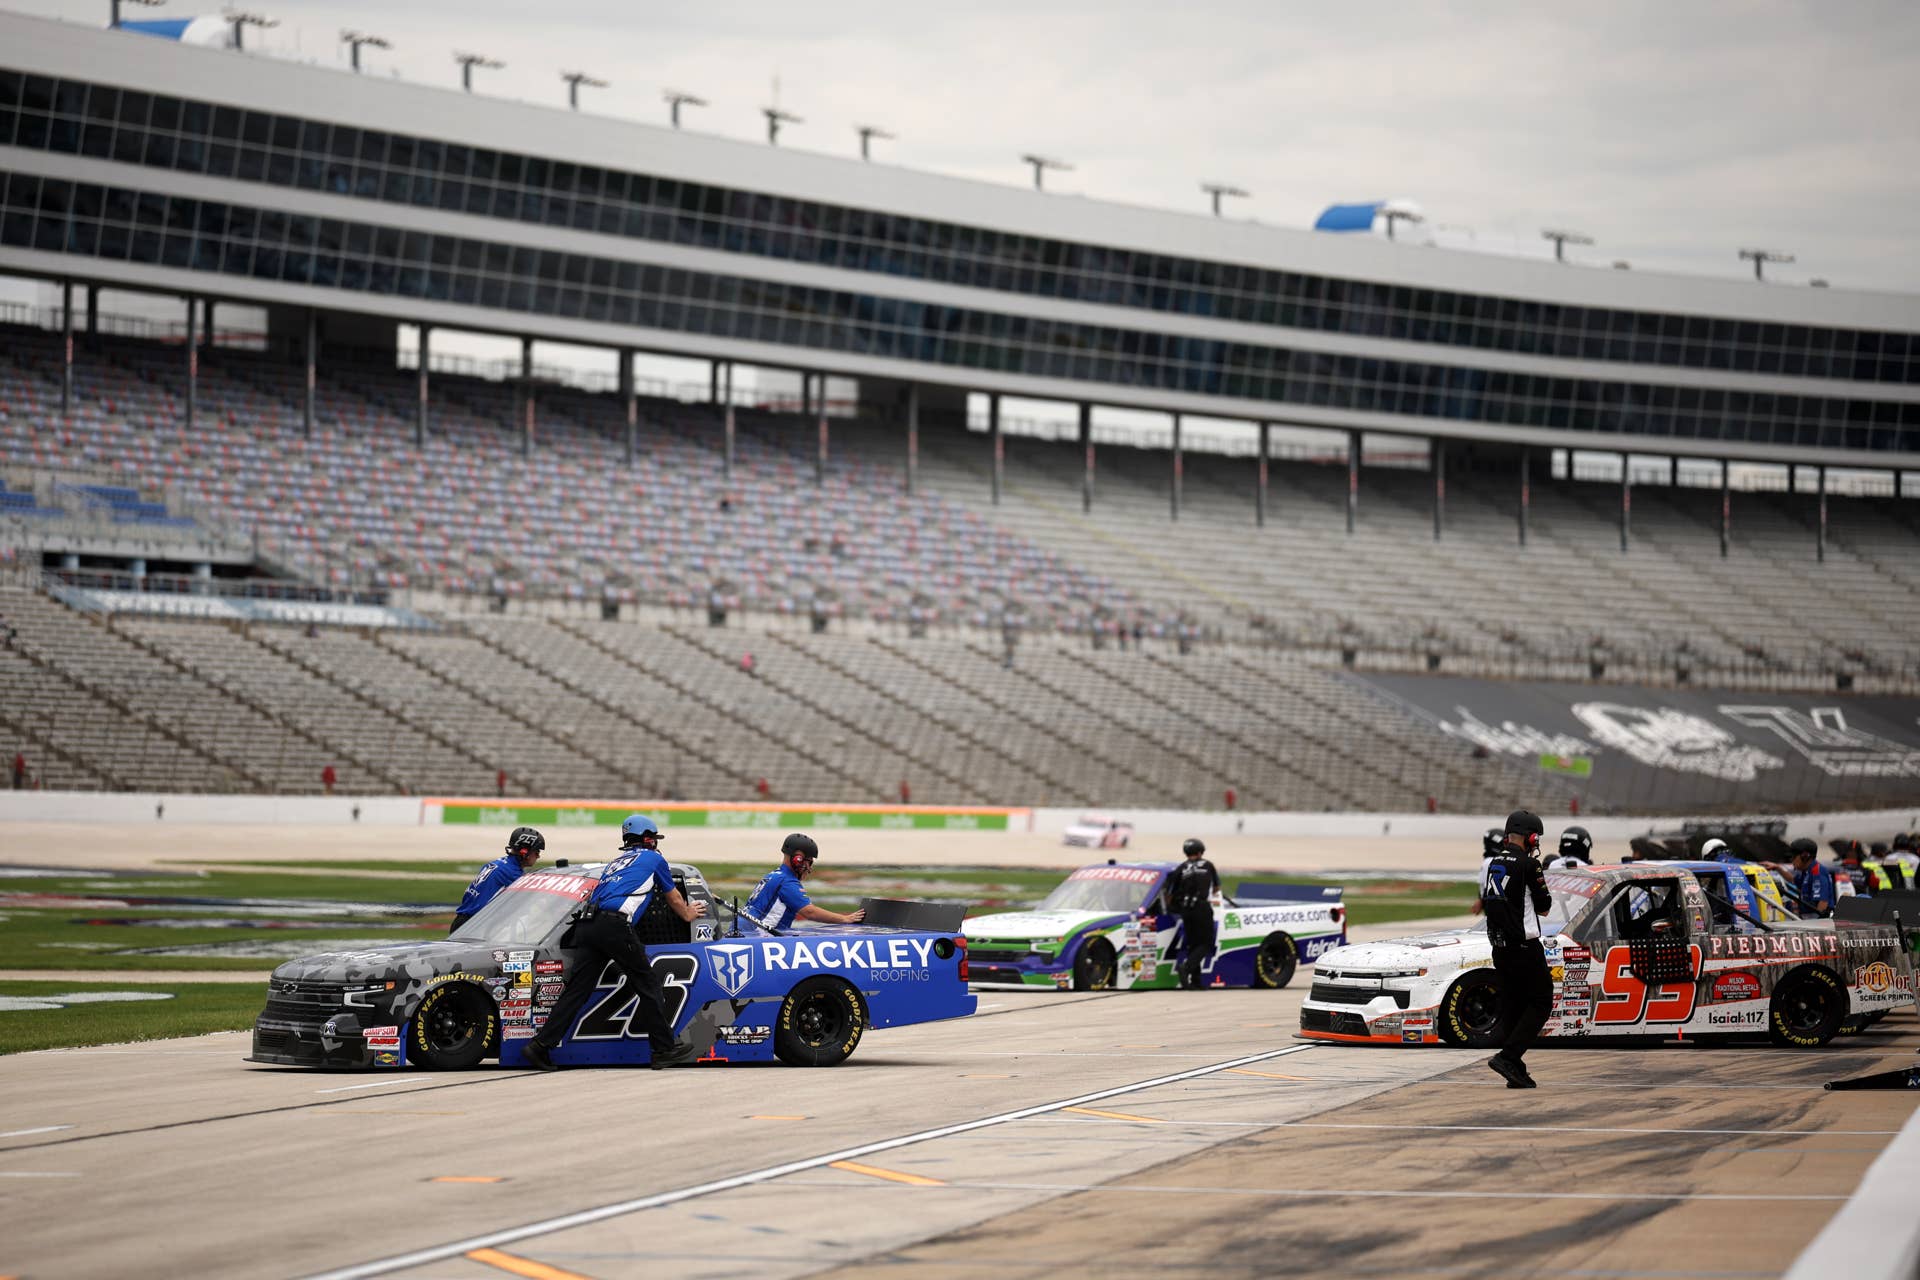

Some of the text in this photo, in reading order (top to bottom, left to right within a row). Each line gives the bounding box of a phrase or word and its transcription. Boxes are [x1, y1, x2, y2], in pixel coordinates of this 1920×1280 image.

[1243, 909, 1331, 926] acceptance.com
[1544, 948, 1561, 956] KF
[1710, 936, 1901, 954] PIEDMONT OUTFITTER
[762, 939, 934, 971] RACKLEY
[504, 962, 530, 971] SKF
[871, 969, 930, 982] ROOFING
[1811, 970, 1837, 988] EAGLE
[1884, 967, 1920, 990] Worh
[783, 996, 796, 1031] EAGLE
[364, 1027, 397, 1036] SIMPSON
[482, 1015, 494, 1048] EAGLE
